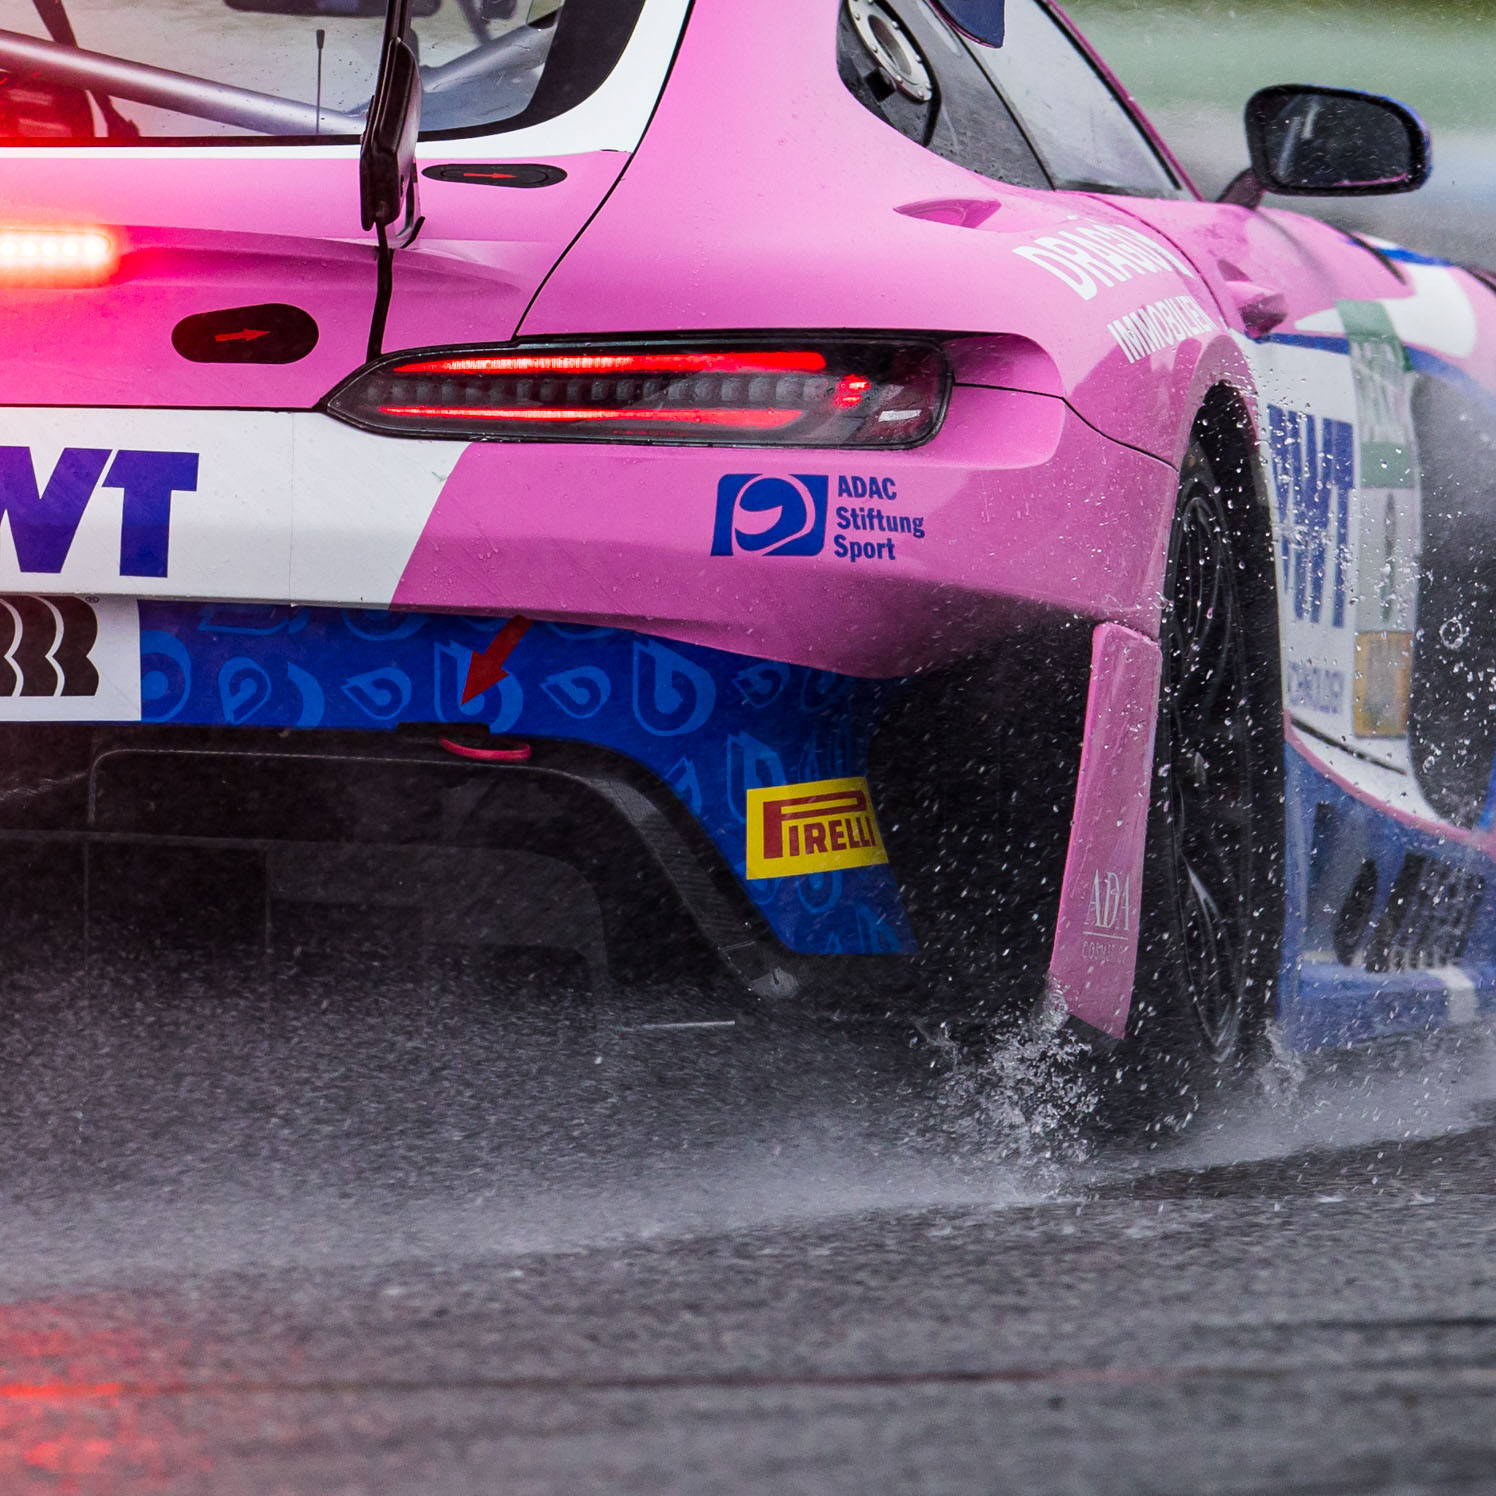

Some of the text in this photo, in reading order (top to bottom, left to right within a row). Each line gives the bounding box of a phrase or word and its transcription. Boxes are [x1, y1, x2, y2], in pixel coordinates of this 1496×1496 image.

[837, 475, 897, 500] ADAC
[835, 506, 925, 539] Stiftung
[833, 534, 896, 562] Sport
[763, 790, 876, 859] PIRELLI
[1083, 869, 1130, 931] ADA
